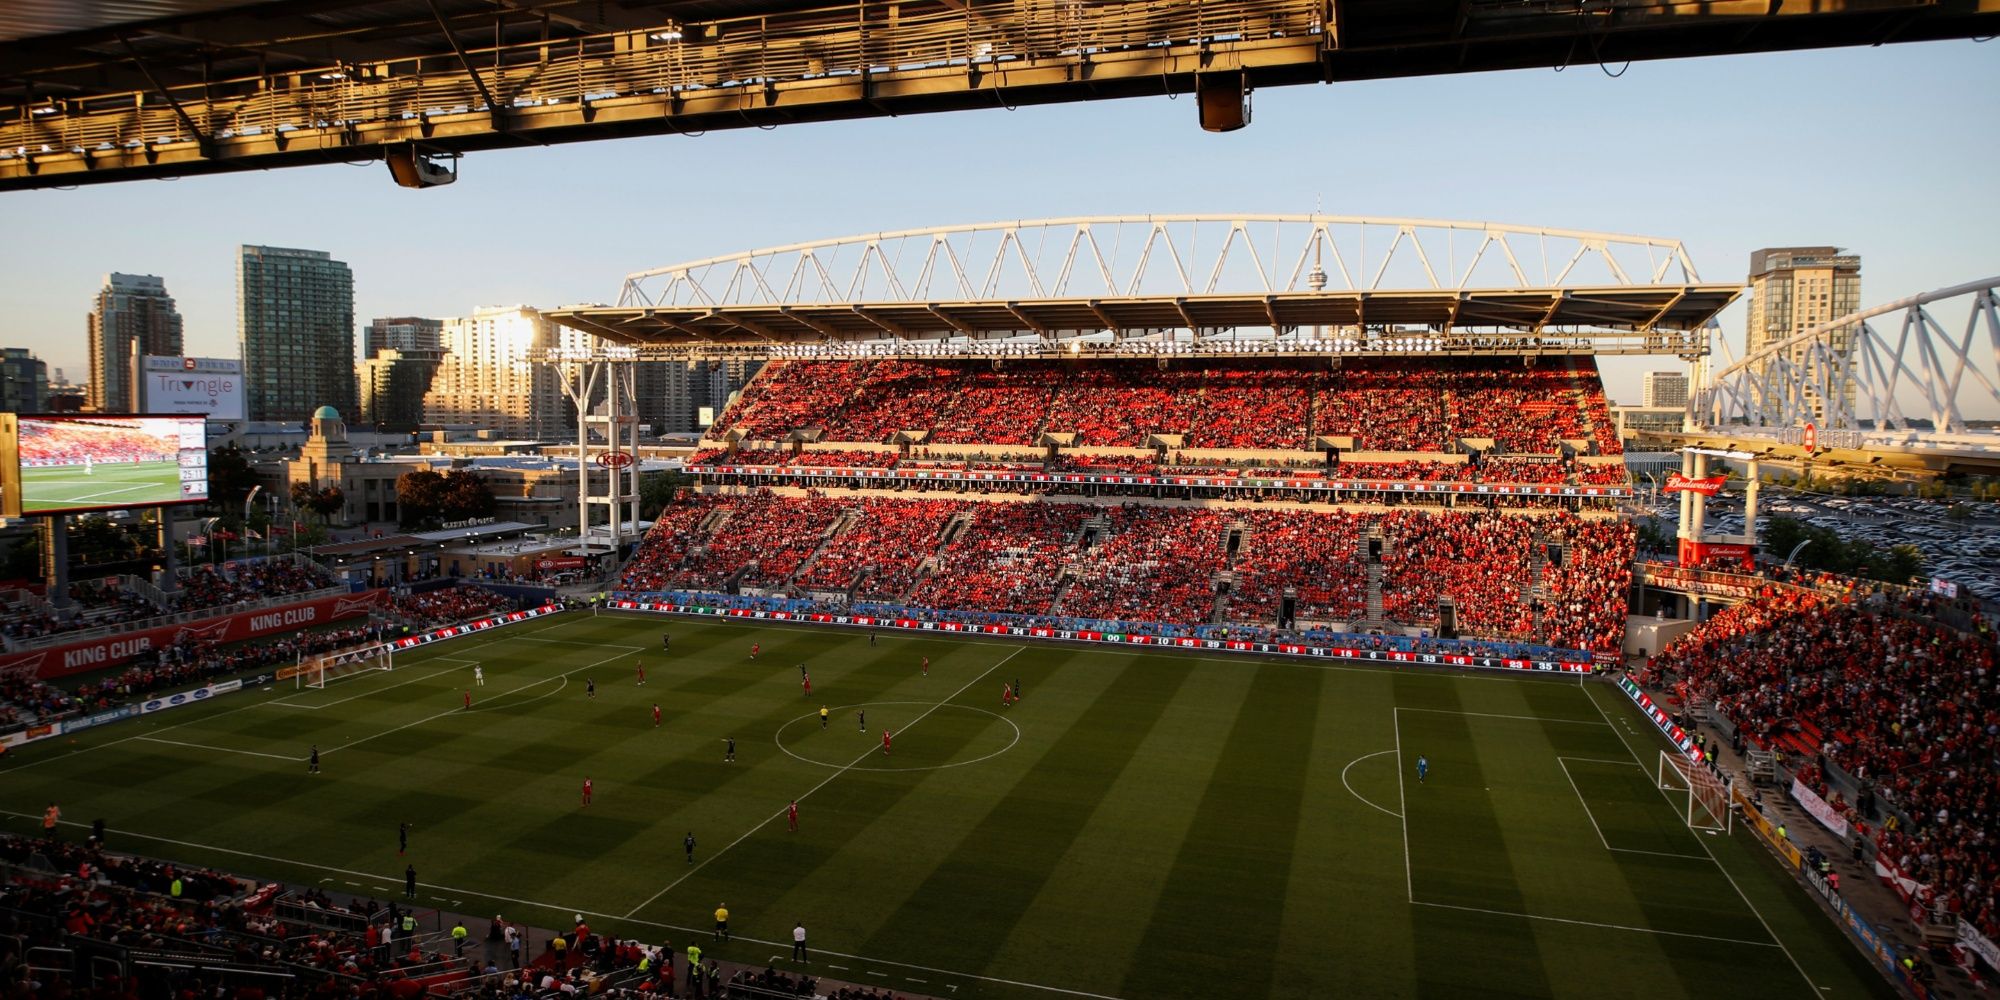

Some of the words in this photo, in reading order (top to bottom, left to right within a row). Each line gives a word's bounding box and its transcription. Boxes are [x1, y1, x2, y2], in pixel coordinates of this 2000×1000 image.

[1666, 478, 1720, 490] Budweiser
[1708, 546, 1746, 554] Budweiser
[250, 612, 282, 631] KING
[285, 606, 315, 625] CLUB
[64, 646, 106, 668] KING
[110, 637, 150, 659] CLUB
